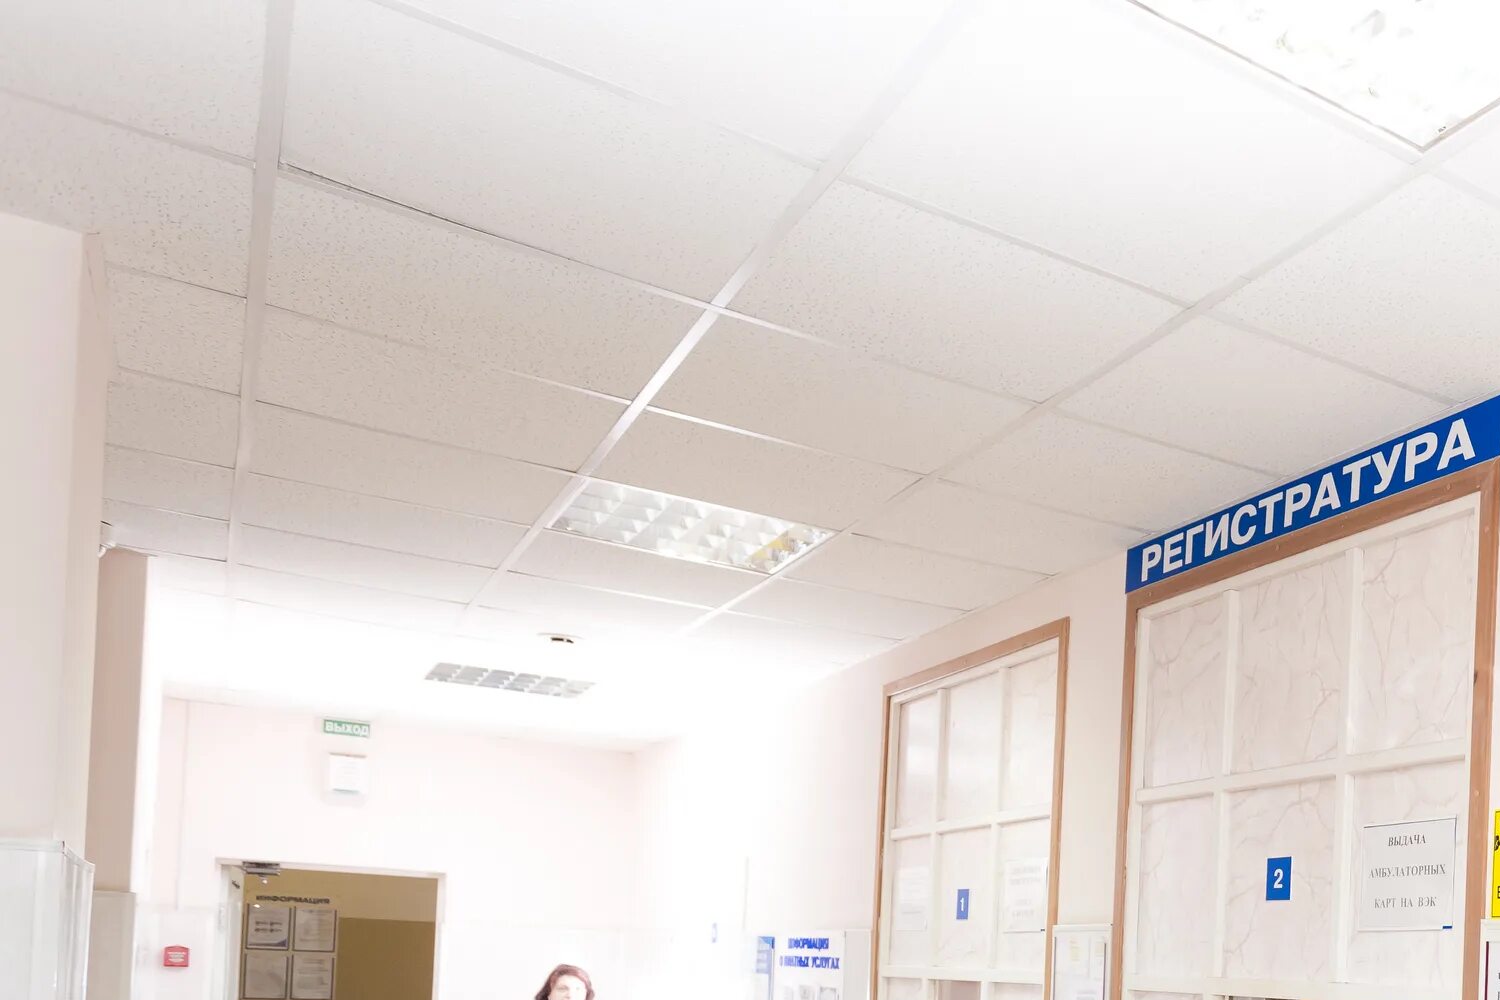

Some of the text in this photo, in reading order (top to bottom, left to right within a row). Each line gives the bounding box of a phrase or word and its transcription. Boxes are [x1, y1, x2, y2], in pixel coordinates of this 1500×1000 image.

[1141, 418, 1476, 583] РЕГИСТРАТУРА
[326, 722, 370, 736] ВЫХОД
[1388, 834, 1426, 846] ВЫДАЧА
[1274, 868, 1284, 888] 2
[1369, 864, 1446, 878] АМБУЛАТОРНЫХ
[256, 896, 330, 904] ИНФОРМАЦИЯ
[960, 897, 965, 911] 1
[1374, 896, 1436, 908] КАРТ НА ВЭК
[788, 937, 829, 951] ИНФОРМАЦИЯ
[812, 957, 840, 969] УСЛУГАХ
